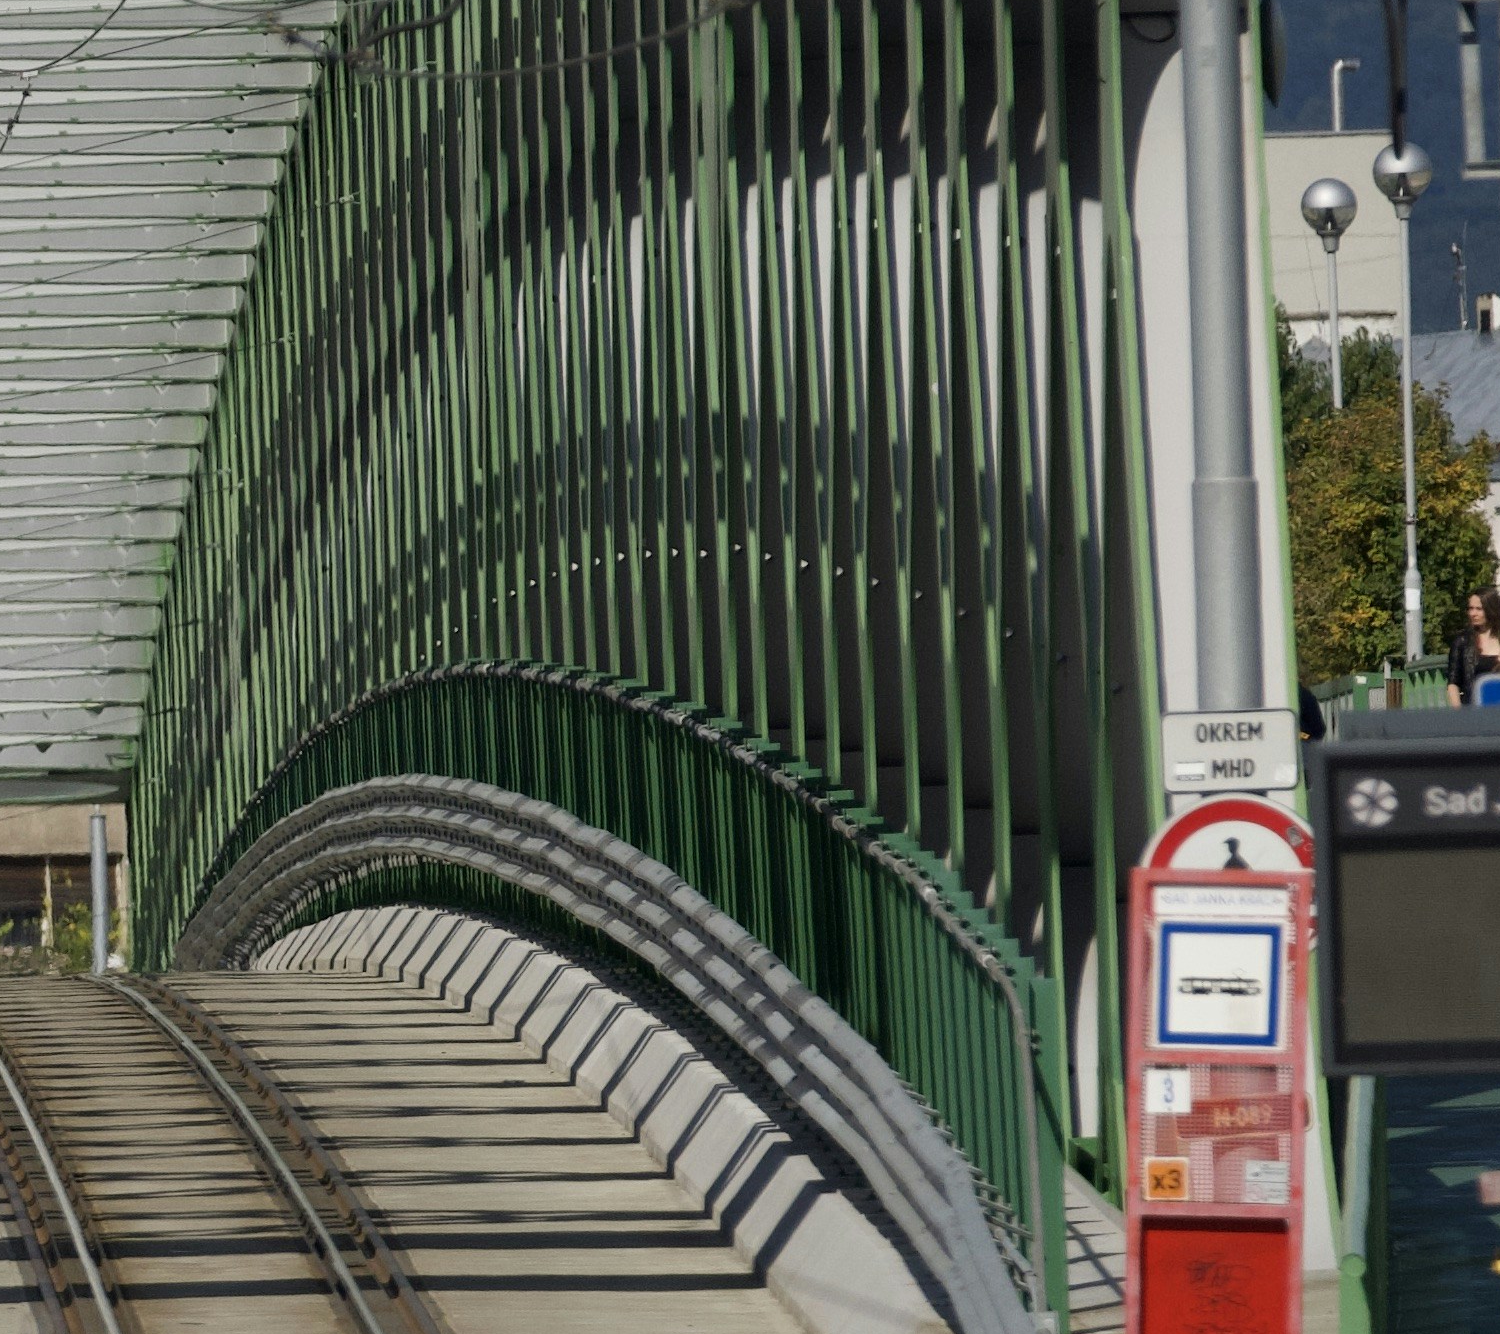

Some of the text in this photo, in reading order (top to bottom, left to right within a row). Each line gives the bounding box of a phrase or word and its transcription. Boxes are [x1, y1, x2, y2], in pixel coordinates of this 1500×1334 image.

[1195, 721, 1265, 744] OKREM
[1211, 758, 1256, 780] MHD
[1424, 784, 1486, 815] Sad
[1162, 1075, 1176, 1104] 3
[1152, 1168, 1182, 1191] x3
